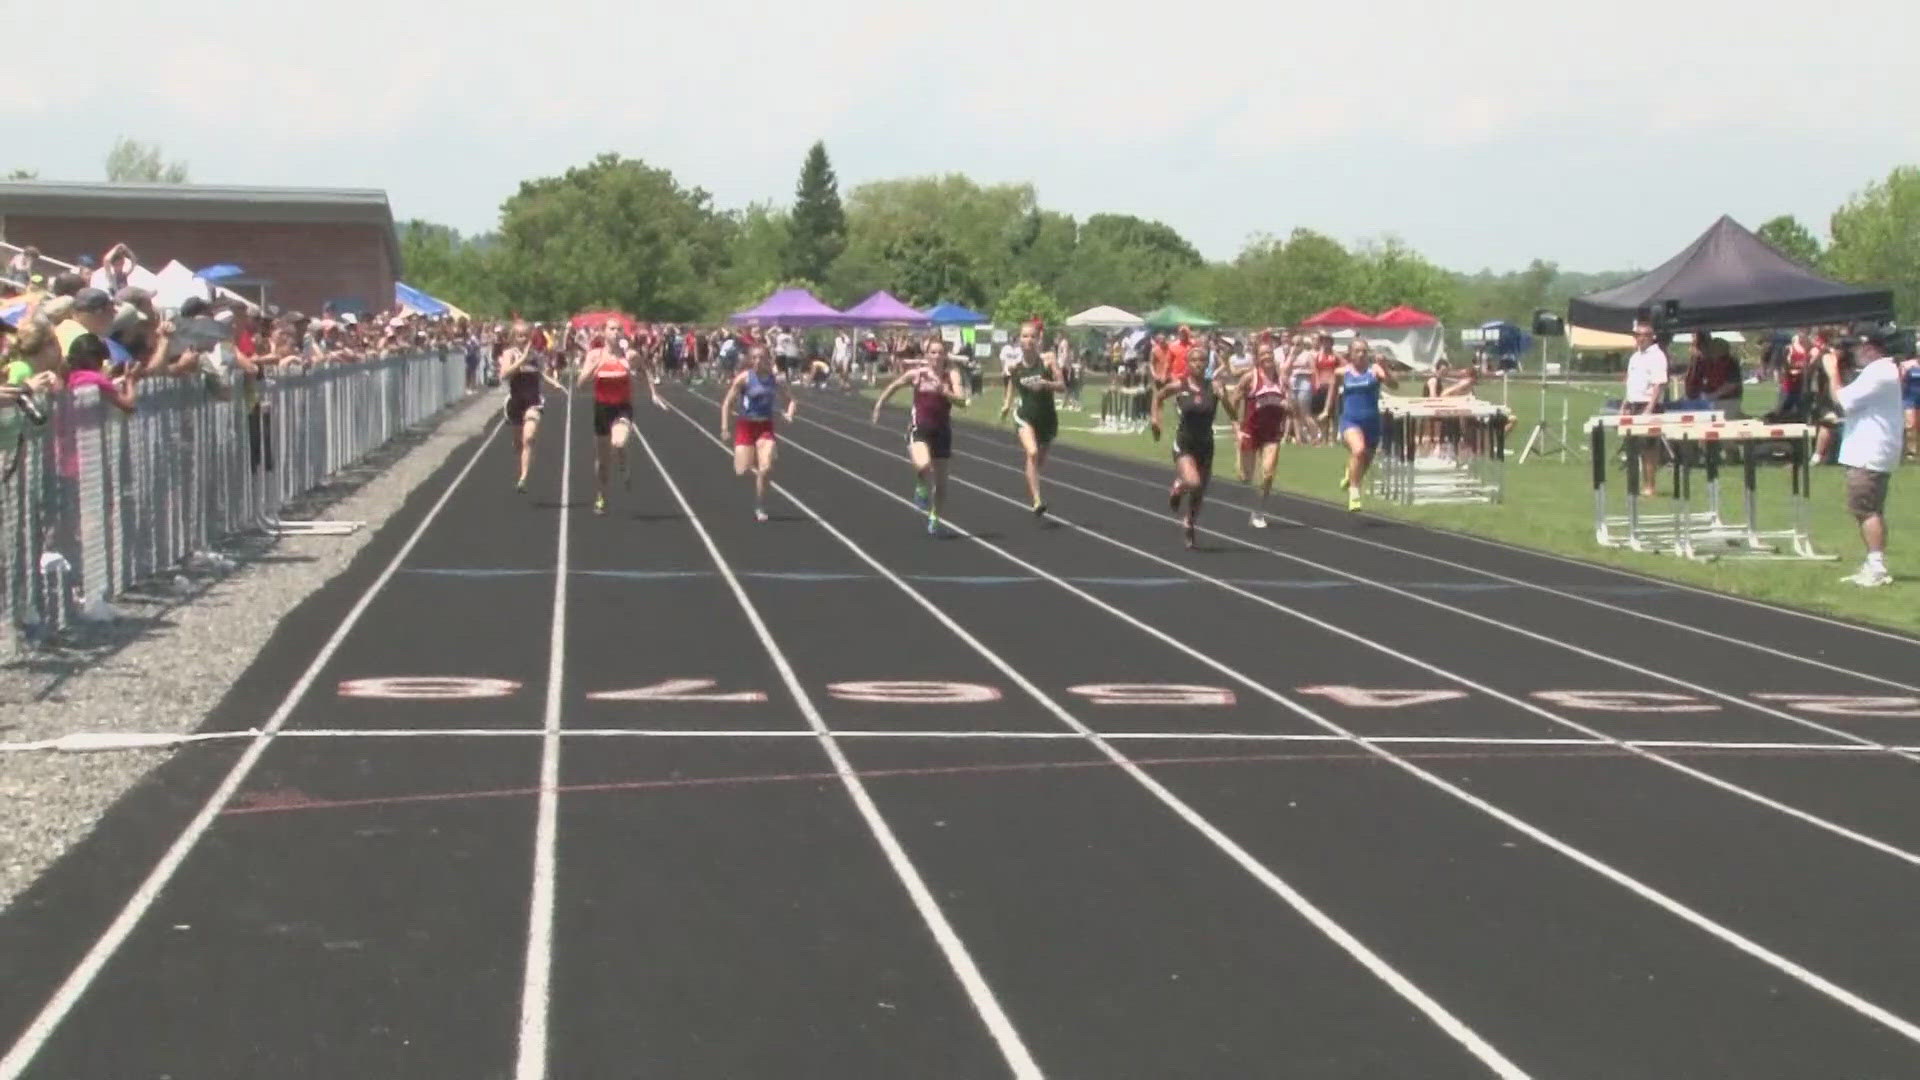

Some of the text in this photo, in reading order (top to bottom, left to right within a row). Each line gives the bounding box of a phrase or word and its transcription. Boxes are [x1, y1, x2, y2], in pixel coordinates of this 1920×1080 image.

[337, 676, 523, 699] 8
[585, 678, 770, 703] 7
[1066, 682, 1237, 706] 5
[1295, 684, 1469, 708] 4
[1529, 689, 1724, 713] 3
[1749, 692, 1920, 718] 2
